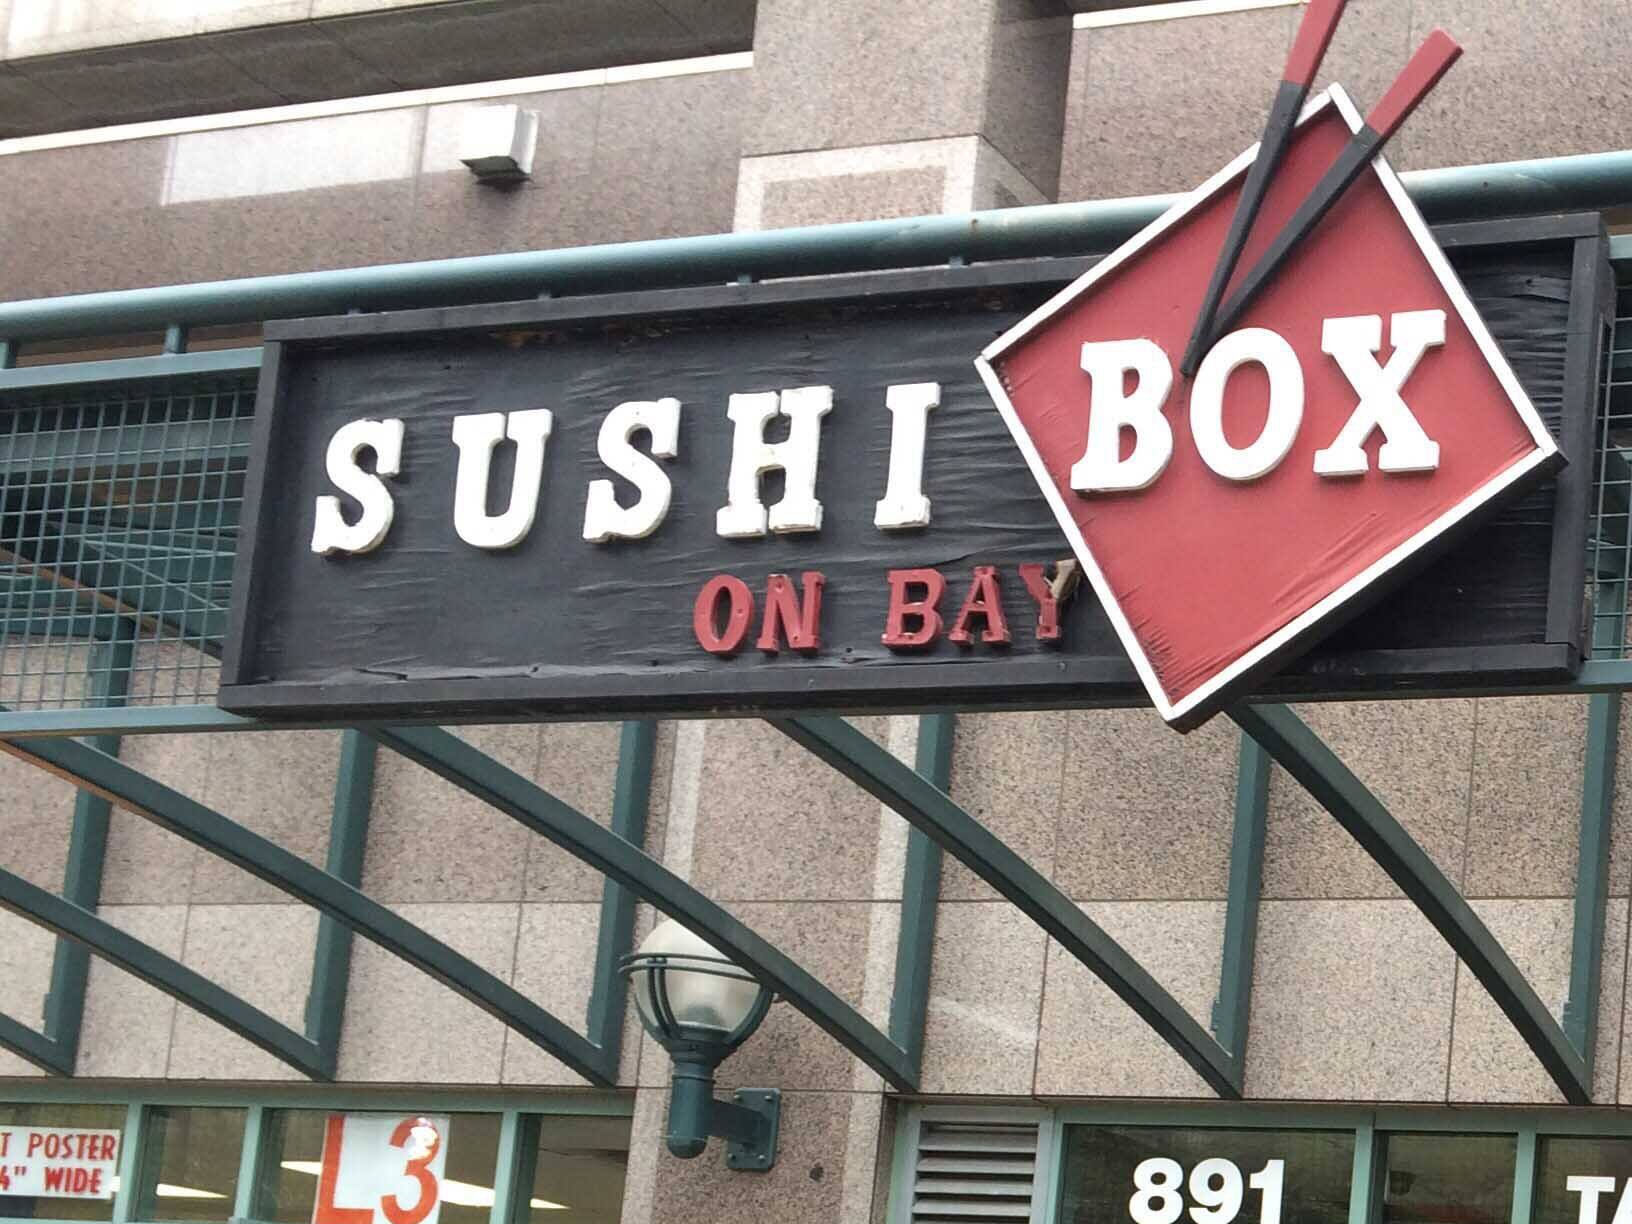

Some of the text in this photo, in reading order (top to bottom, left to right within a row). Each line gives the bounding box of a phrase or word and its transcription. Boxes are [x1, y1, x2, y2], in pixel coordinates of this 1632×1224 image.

[311, 309, 1447, 556] SUSHI BOX
[693, 558, 1080, 656] ON BAY
[27, 1133, 116, 1160] POSTER
[44, 1166, 102, 1194] WIDE
